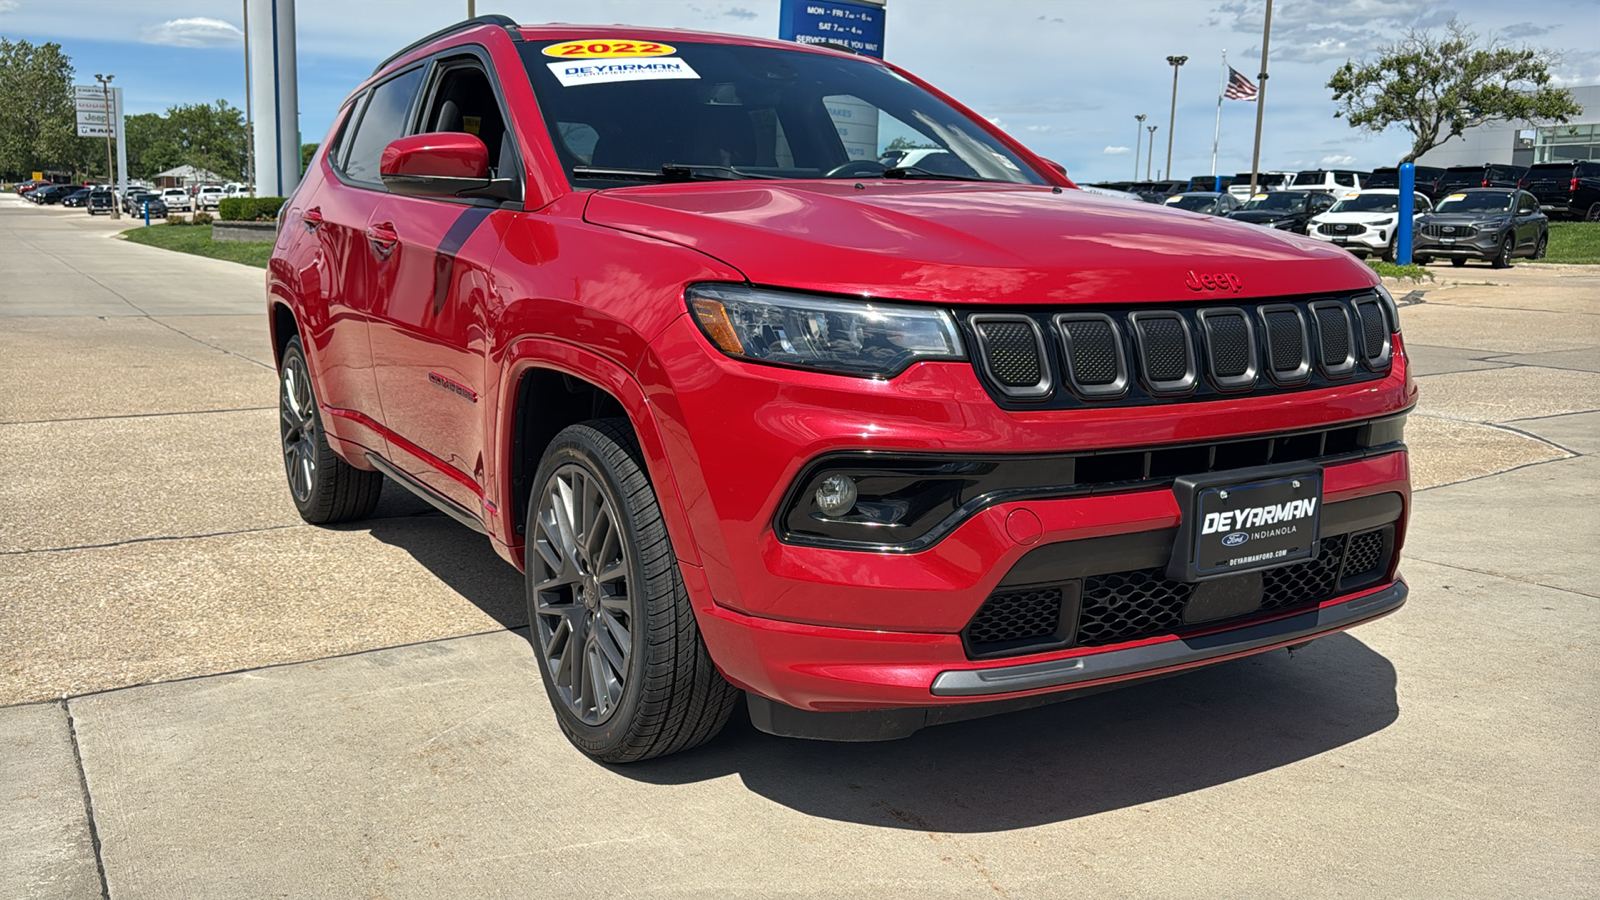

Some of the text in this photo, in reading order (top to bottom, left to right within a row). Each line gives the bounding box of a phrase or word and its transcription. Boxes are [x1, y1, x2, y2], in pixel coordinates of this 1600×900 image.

[807, 6, 825, 15] MON
[832, 9, 844, 17] FRI
[818, 22, 832, 30] SAT
[561, 43, 663, 55] 2022
[796, 34, 827, 43] SERVICE
[850, 40, 863, 49] YOU
[864, 43, 878, 51] WAIT
[565, 63, 681, 75] DEYARMAN
[85, 113, 107, 122] Jeep
[1185, 269, 1243, 294] Jeep
[1201, 497, 1317, 535] DEYARMAN
[1226, 525, 1297, 544] Ford INDIANOLA
[1229, 549, 1287, 566] DEYARMANFORD.COM
